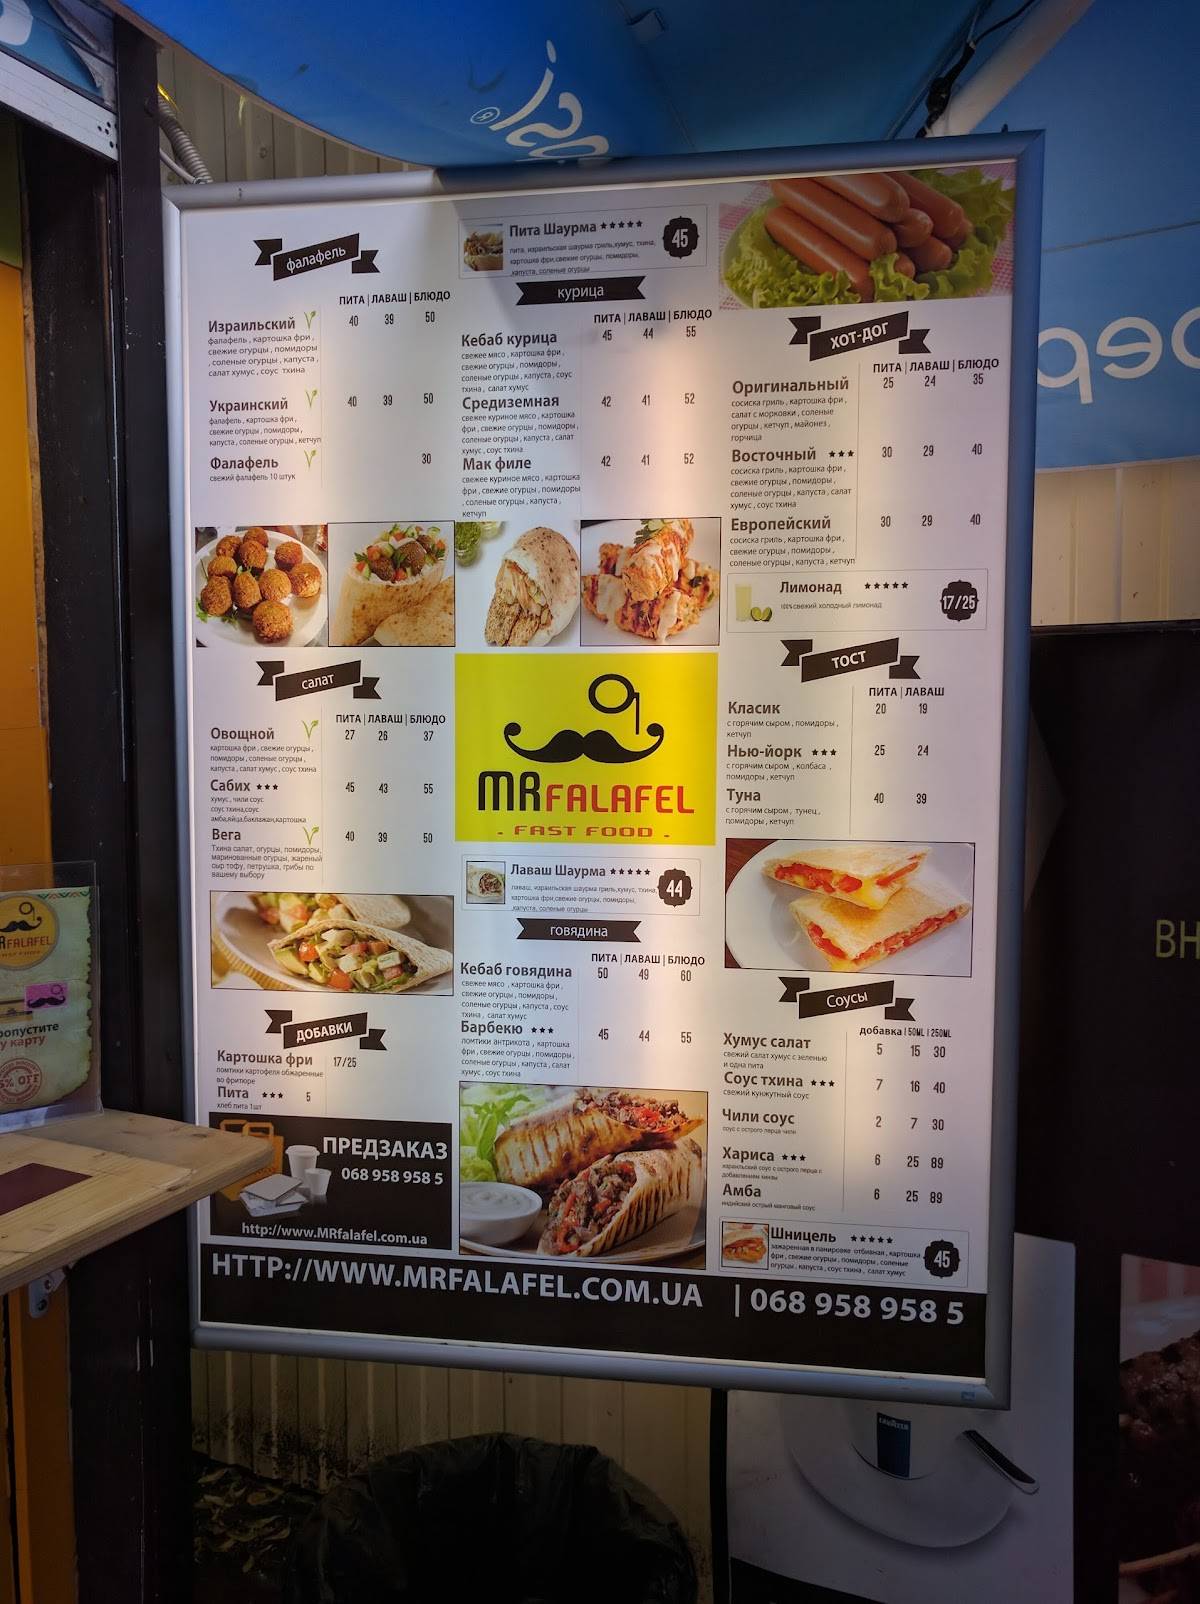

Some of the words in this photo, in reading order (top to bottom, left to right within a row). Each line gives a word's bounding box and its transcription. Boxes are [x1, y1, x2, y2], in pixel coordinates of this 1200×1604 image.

[509, 224, 541, 238] Пита
[543, 222, 597, 237] Шаурма
[671, 228, 689, 249] 45
[286, 246, 346, 273] фалафель
[339, 295, 366, 305] ПИТА
[371, 292, 407, 304] ЛАВАШ
[413, 290, 451, 303] БЛЮДО
[557, 285, 604, 302] курица
[348, 315, 359, 327] 40
[384, 313, 394, 325] 39
[425, 311, 436, 323] 50
[593, 313, 622, 324] ПИТА
[627, 311, 666, 322] ЛАВАШ
[673, 308, 713, 321] БЛЮДО
[208, 316, 296, 336] Израильский
[602, 329, 613, 341] 45
[642, 327, 654, 340] 44
[686, 325, 697, 338] 55
[461, 331, 504, 347] Кебаб
[506, 333, 558, 349] курица
[873, 362, 902, 374] ПИТА
[909, 360, 950, 372] ЛАВАШ
[957, 358, 1000, 371] БЛЮДО
[732, 376, 849, 398] Оригинальный
[883, 376, 895, 389] 25
[924, 374, 936, 388] 24
[972, 372, 984, 385] 35
[209, 396, 288, 415] Украинский
[462, 396, 560, 413] Средиземная
[601, 395, 612, 408] 42
[641, 394, 651, 406] 41
[684, 392, 695, 405] 52
[421, 452, 432, 465] 30
[731, 446, 817, 463] Восточный
[881, 446, 893, 458] 30
[922, 444, 934, 457] 29
[971, 443, 983, 456] 40
[210, 455, 279, 472] Фалафель
[462, 457, 492, 471] Мак
[494, 456, 532, 473] филе
[731, 515, 831, 535] Европейский
[779, 581, 842, 595] Лимонад
[942, 594, 976, 610] 17/25
[832, 651, 866, 669] ТОСТ
[301, 673, 336, 691] салат
[868, 687, 898, 697] ПИТА
[904, 687, 945, 697] ЛАВАШ
[728, 701, 781, 715] Класик
[875, 702, 887, 715] 20
[918, 702, 928, 715] 19
[335, 714, 362, 724] ПИТА
[367, 714, 403, 724] ЛАВАШ
[409, 714, 446, 726] БЛЮДО
[210, 727, 275, 743] Овощной
[344, 729, 356, 741] 27
[378, 730, 388, 742] 26
[423, 730, 434, 742] 37
[727, 743, 802, 761] Нью-йорк
[874, 744, 886, 756] 25
[917, 744, 929, 757] 24
[210, 778, 251, 792] Сабих
[726, 788, 761, 805] Туна
[212, 828, 241, 841] Вега
[514, 825, 577, 838] FAST
[585, 826, 653, 838] FOOD
[510, 863, 552, 876] Лаваш
[555, 864, 606, 880] Шаурма
[665, 879, 683, 898] 44
[550, 926, 608, 939] говядина
[591, 953, 618, 963] ПИТА
[624, 954, 661, 964] ЛАВАШ
[667, 955, 706, 967] БЛЮДО
[460, 961, 503, 976] Кебаб
[505, 966, 572, 980] говядина
[597, 966, 609, 979] 50
[638, 968, 649, 981] 49
[680, 969, 692, 982] 60
[826, 990, 868, 1009] Соусы
[296, 1022, 352, 1043] ДОБАВКИ
[461, 1019, 523, 1037] Барбекю
[859, 1025, 903, 1037] добавка
[723, 1032, 768, 1050] Хумус
[770, 1037, 812, 1049] салат
[217, 1049, 283, 1066] Картошка
[285, 1052, 313, 1068] фри
[876, 1042, 884, 1056] 5
[910, 1044, 921, 1057] 15
[933, 1045, 946, 1058] 30
[333, 1056, 357, 1068] 17/25
[723, 1071, 758, 1087] Соус
[760, 1075, 804, 1088] тхина
[217, 1085, 249, 1099] Пита
[305, 1091, 311, 1103] 5
[722, 1108, 760, 1123] Чили
[762, 1113, 795, 1126] соус
[322, 1136, 448, 1161] ПРЕДЗАКАЗ
[722, 1146, 775, 1164] Хариса
[874, 1153, 881, 1166] 6
[906, 1155, 920, 1168] 25
[930, 1156, 944, 1169] 89
[341, 1167, 369, 1181] 068
[371, 1168, 400, 1183] 958
[402, 1170, 431, 1185] 958
[434, 1172, 444, 1186] 5
[722, 1183, 762, 1198] Амба
[770, 1226, 837, 1244] Шницель
[933, 1250, 951, 1269] 45
[750, 1288, 806, 1314] 068
[814, 1292, 872, 1319] 958
[879, 1296, 938, 1323] 958
[946, 1301, 964, 1325] 5
